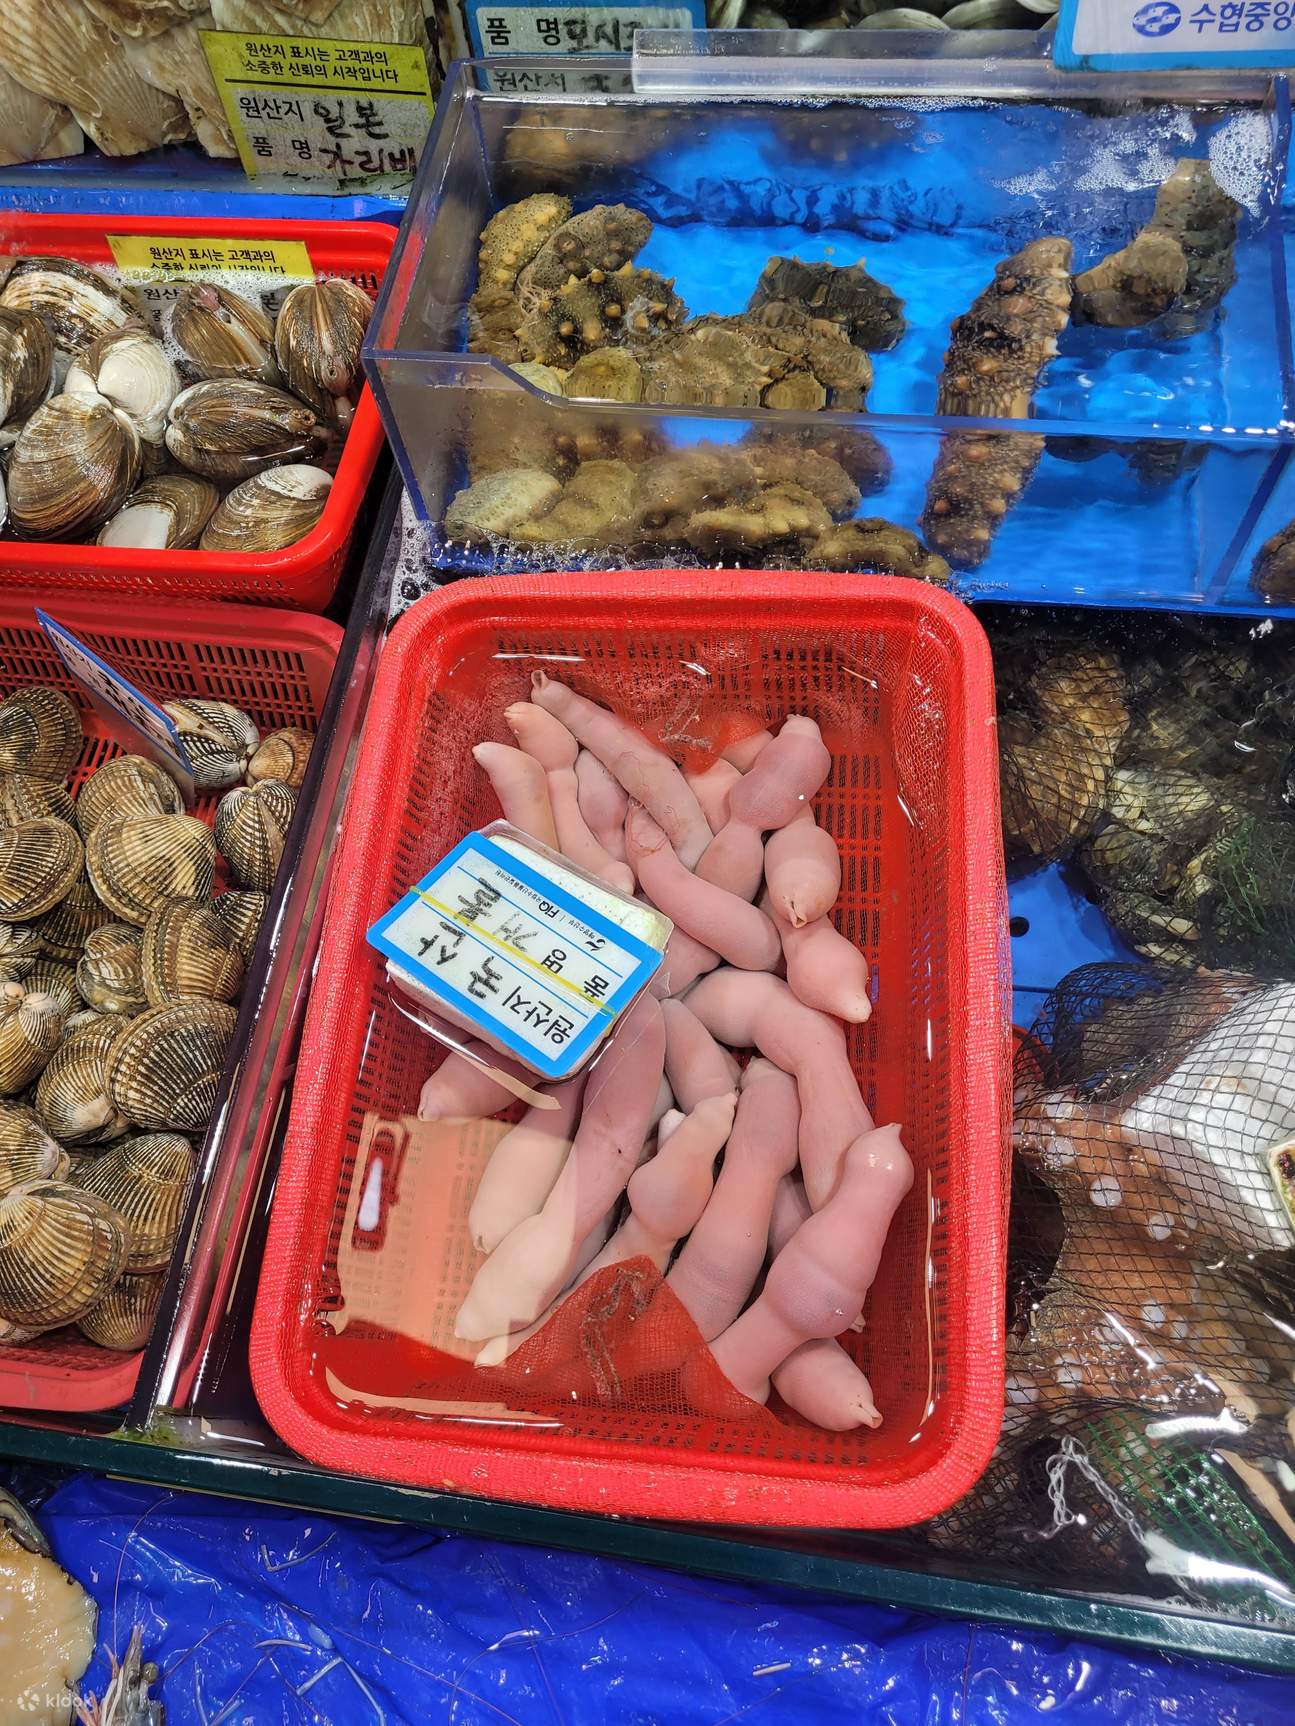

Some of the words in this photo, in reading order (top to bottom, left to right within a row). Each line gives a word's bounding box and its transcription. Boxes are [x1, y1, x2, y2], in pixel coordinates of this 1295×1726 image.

[1188, 1, 1295, 33] 수협중앙
[485, 18, 511, 46] 품
[536, 18, 561, 46] 명
[245, 42, 287, 59] 원산지
[290, 46, 331, 62] 표시는
[335, 49, 388, 66] 고객과의
[244, 60, 284, 76] 소중한
[288, 63, 328, 79] 신뢰의
[333, 67, 399, 83] 시작입니다
[240, 97, 304, 122] 원산지
[313, 99, 390, 140] 일본
[252, 136, 274, 157] 품
[291, 139, 313, 160] 명
[149, 247, 186, 261] 원산지
[189, 249, 224, 262] 표시는
[227, 249, 276, 263] 고객과의
[144, 288, 179, 300] 원산
[540, 948, 567, 974] 명
[502, 985, 575, 1043] 원산지
